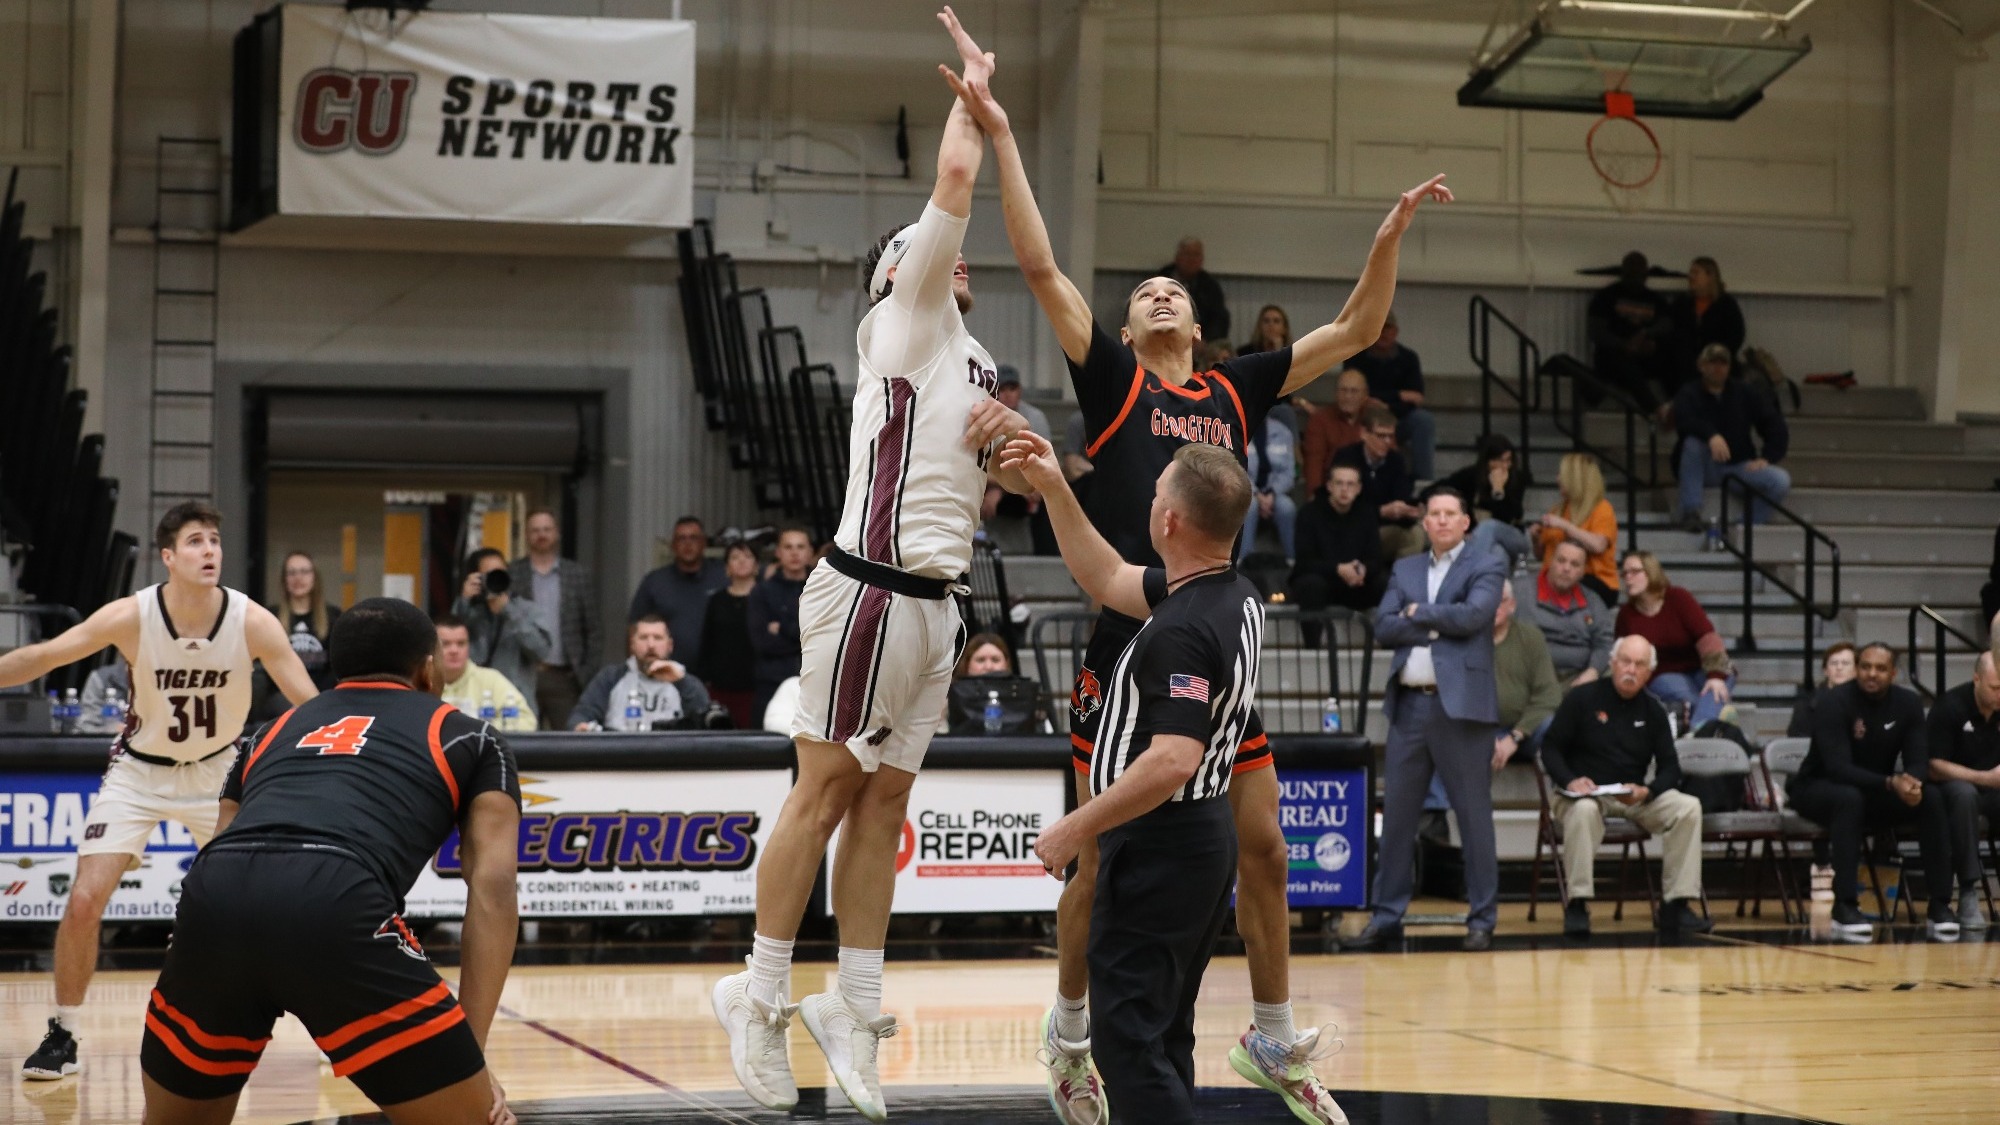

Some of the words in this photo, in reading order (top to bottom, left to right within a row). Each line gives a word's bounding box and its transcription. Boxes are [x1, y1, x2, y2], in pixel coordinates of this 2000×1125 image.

[441, 75, 678, 123] SPORTS
[296, 69, 417, 154] CU
[437, 118, 682, 164] NETWORK
[155, 669, 232, 690] TIGERS
[167, 694, 217, 743] 34
[296, 715, 375, 755] 4
[1278, 780, 1348, 800] OUNTY
[920, 810, 969, 829] CELL
[973, 810, 1041, 829] PHONE
[84, 823, 109, 840] CU
[528, 881, 625, 893] CONDITIONING
[643, 880, 700, 893] HEATING
[529, 900, 619, 912] RESIDENTIAL
[625, 900, 674, 911] WIRING
